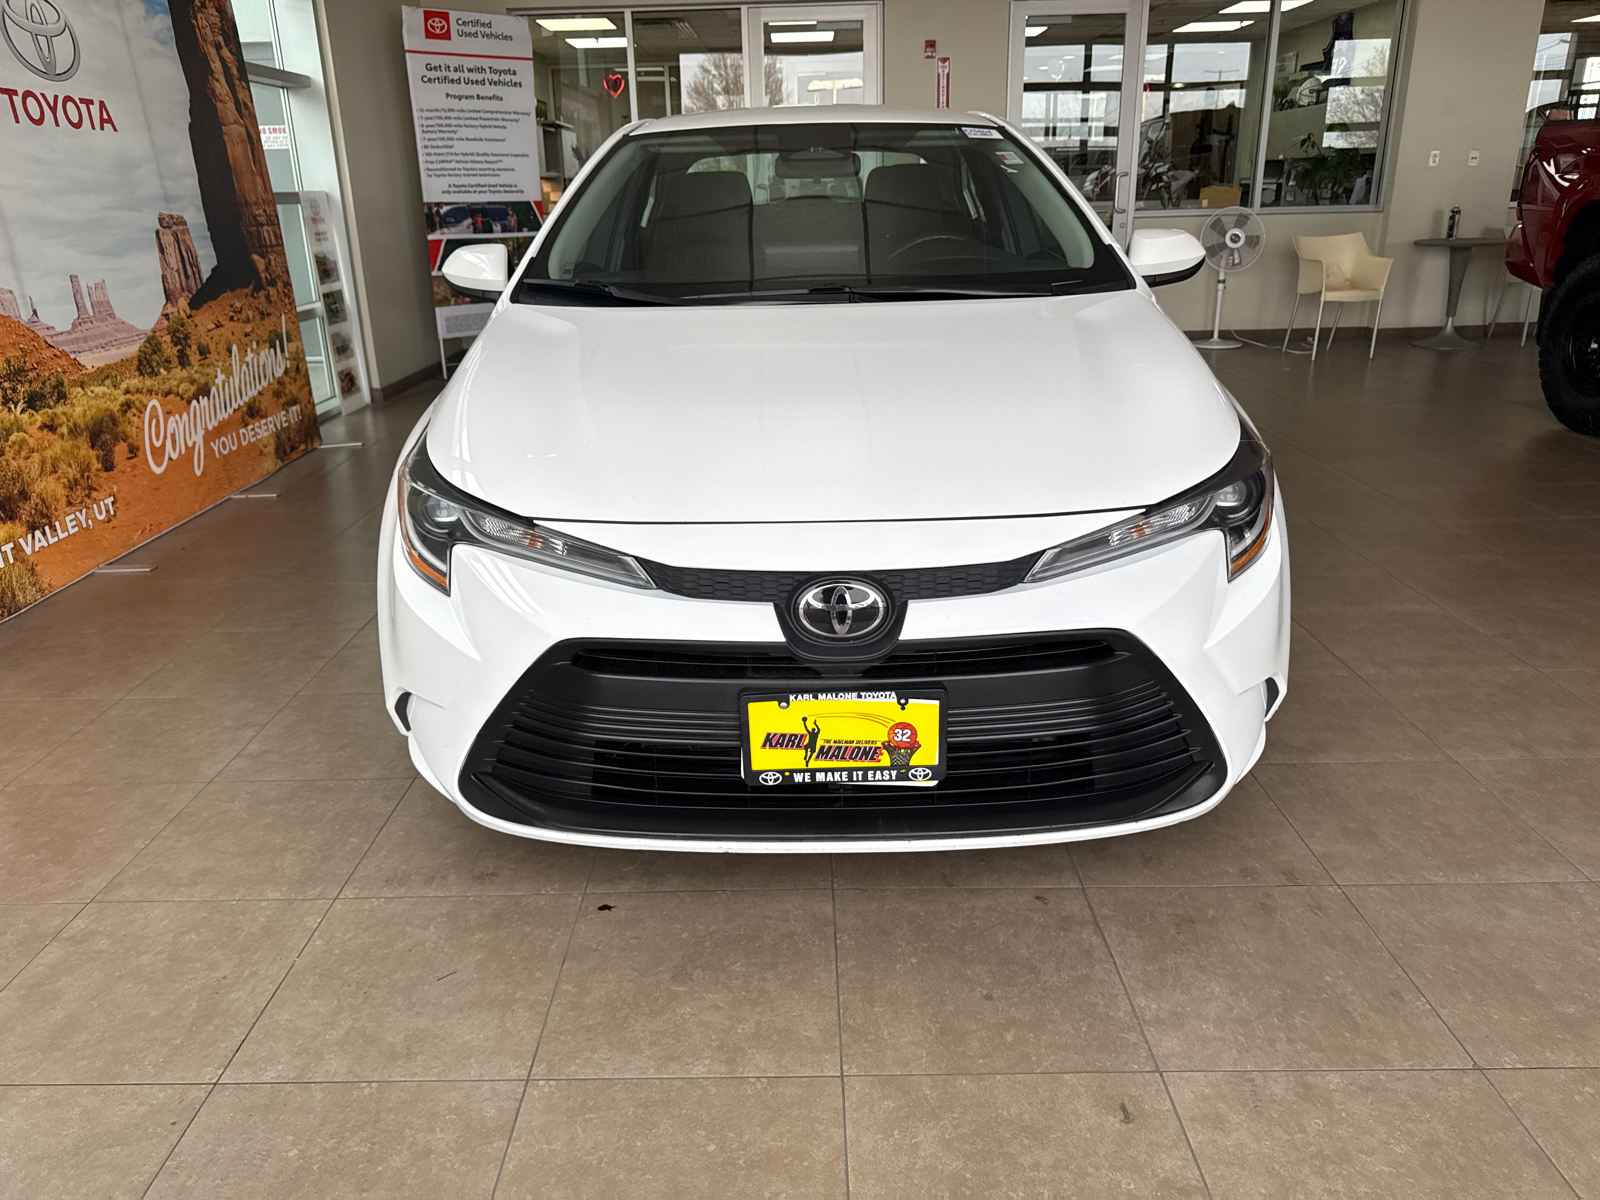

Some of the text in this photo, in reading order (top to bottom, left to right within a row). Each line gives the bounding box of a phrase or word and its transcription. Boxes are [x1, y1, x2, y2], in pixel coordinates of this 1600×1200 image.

[456, 17, 492, 29] Certified
[457, 29, 513, 41] Used Vehicles
[425, 62, 517, 77] Get it all with Toyota
[421, 75, 523, 88] Certified Used Vehicles
[445, 92, 503, 102] Program Benefits
[0, 87, 118, 133] TOYOTA
[144, 314, 290, 476] Congratulations!
[210, 404, 302, 459] YOU DESERVE IT!
[18, 508, 93, 557] VALLEY,
[94, 496, 115, 522] UT
[790, 692, 896, 702] KARL MALONE TOYOTA
[760, 732, 808, 750] KARL
[894, 728, 912, 742] 32
[814, 745, 885, 763] MALONE
[794, 770, 898, 782] WE MAKE IT EASY
